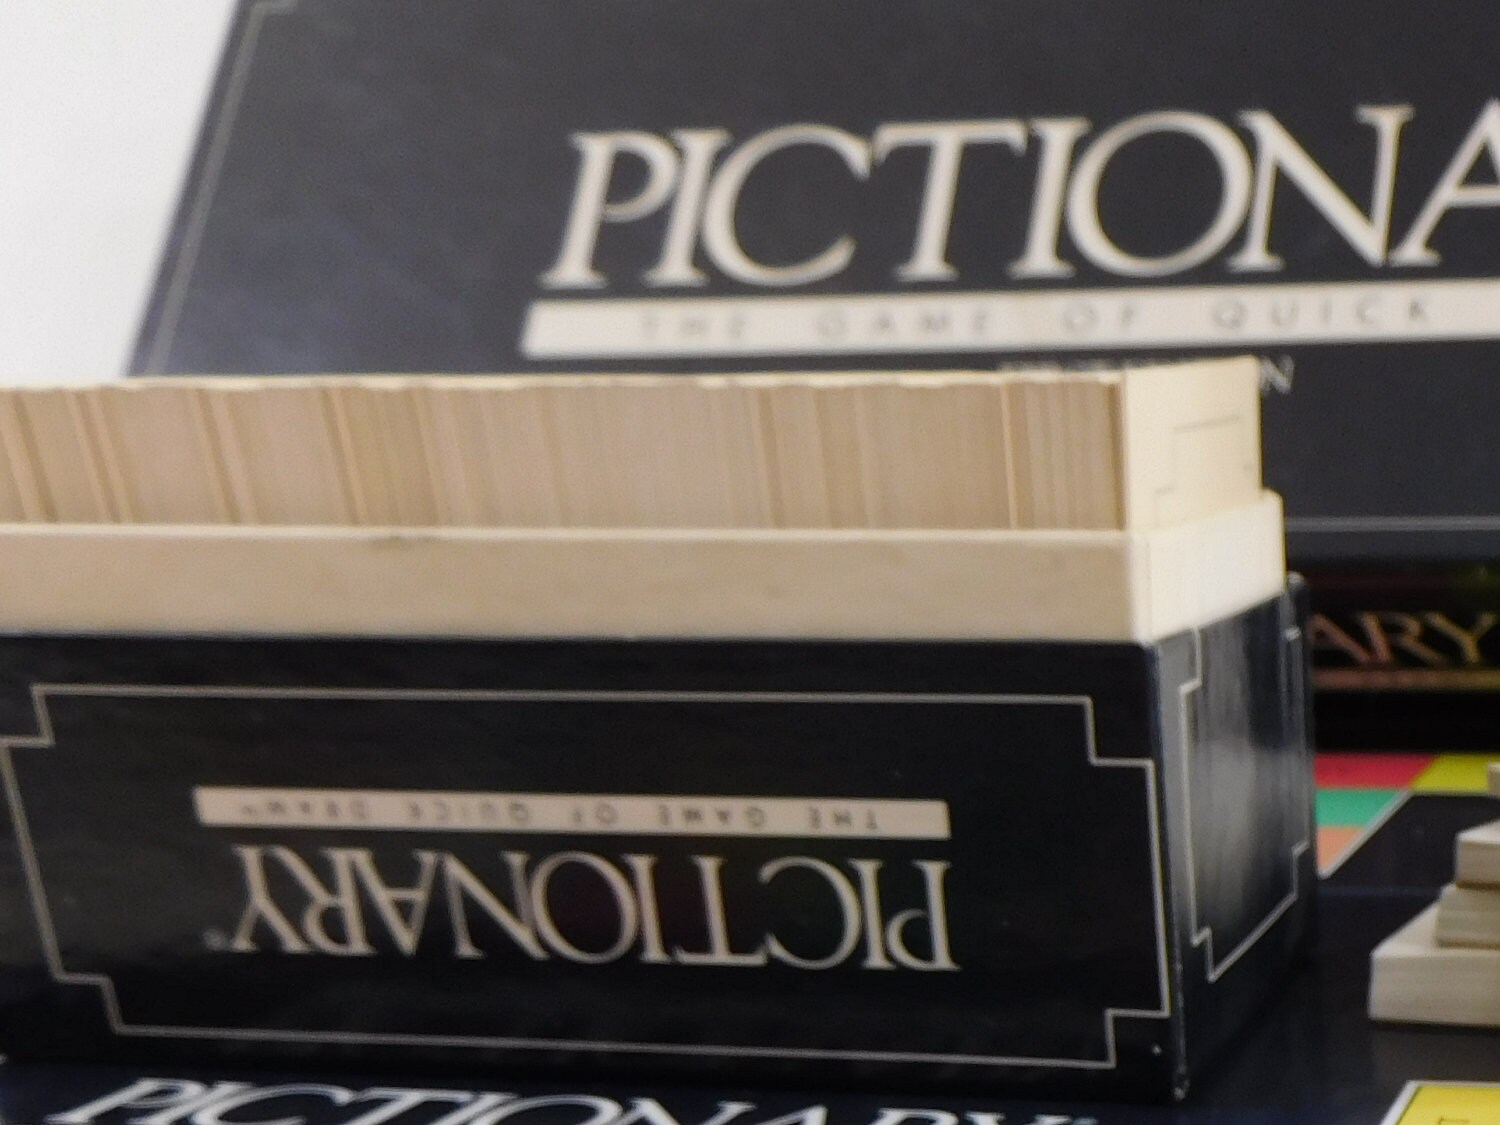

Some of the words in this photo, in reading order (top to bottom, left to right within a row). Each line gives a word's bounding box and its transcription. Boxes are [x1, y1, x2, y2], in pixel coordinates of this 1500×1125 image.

[640, 309, 748, 344] THE
[815, 303, 990, 343] GAME
[1061, 297, 1137, 331] OF
[1210, 298, 1430, 331] QUICK
[407, 800, 530, 826] QUICK
[571, 802, 619, 827] OF
[656, 803, 767, 829] GAME
[809, 803, 878, 831] THE
